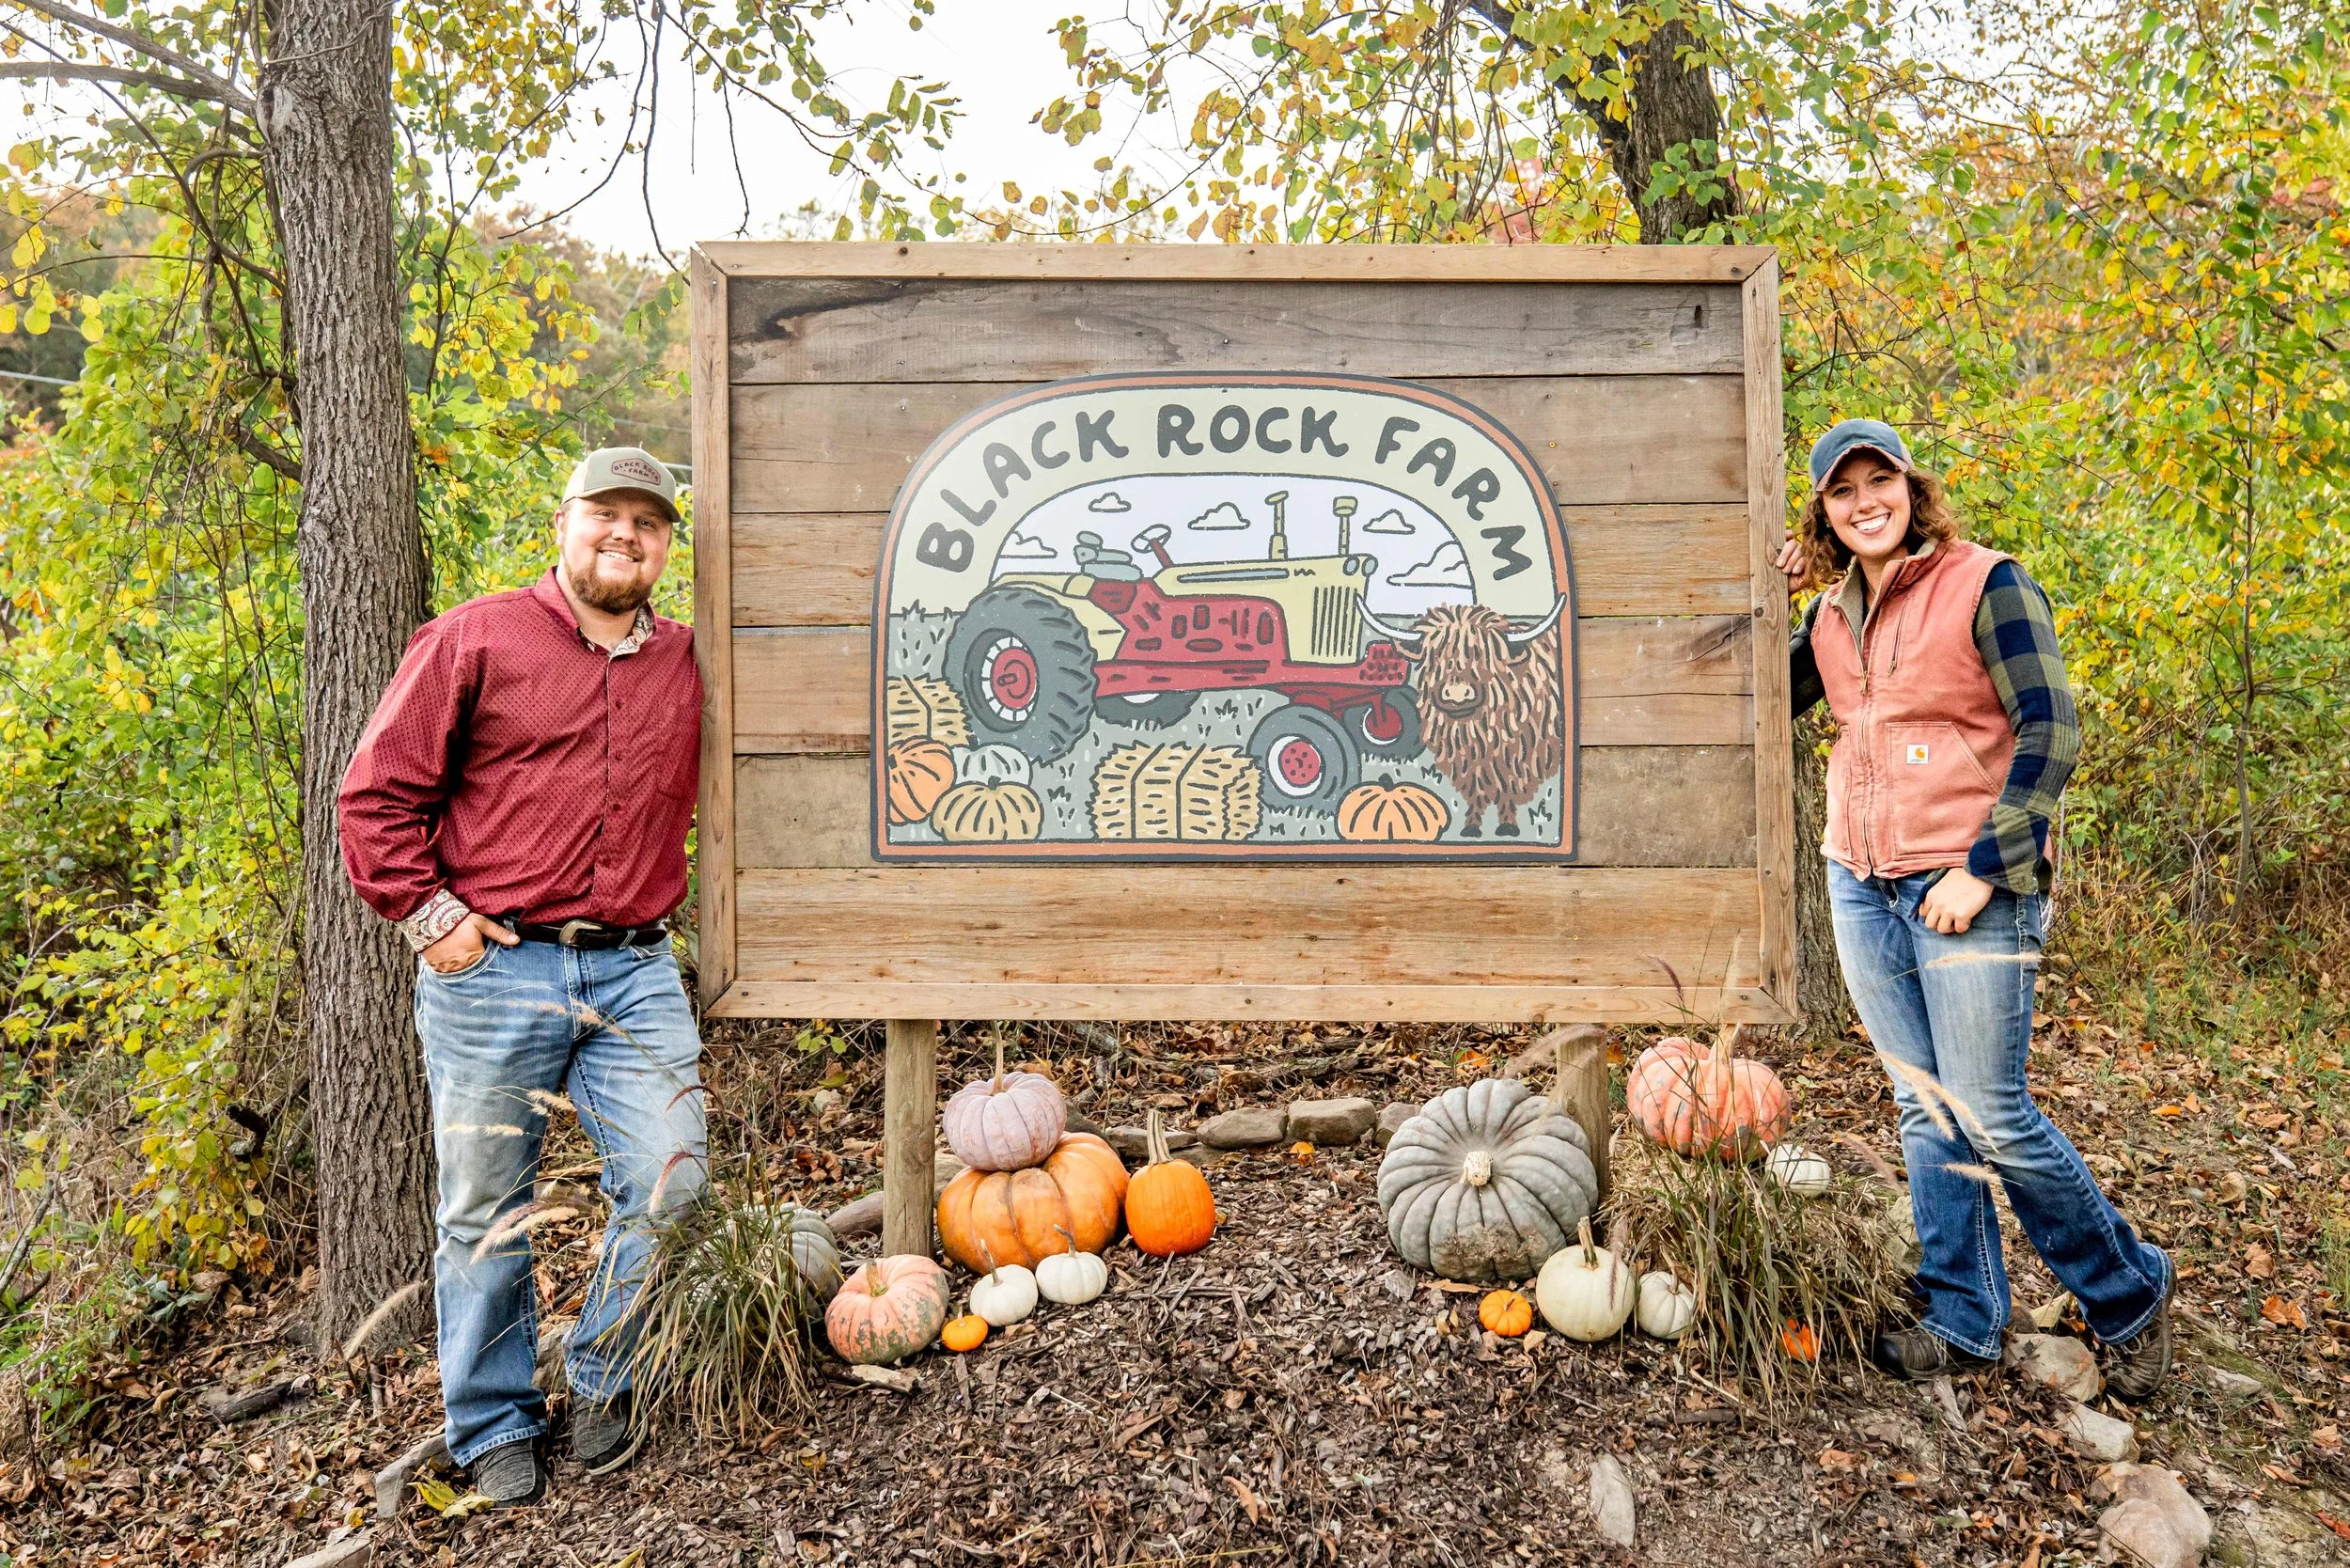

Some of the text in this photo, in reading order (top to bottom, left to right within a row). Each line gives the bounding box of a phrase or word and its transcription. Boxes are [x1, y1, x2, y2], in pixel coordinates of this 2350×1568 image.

[614, 462, 659, 481] BLACK ROCK
[916, 403, 1533, 581] BLACK ROCK FARM
